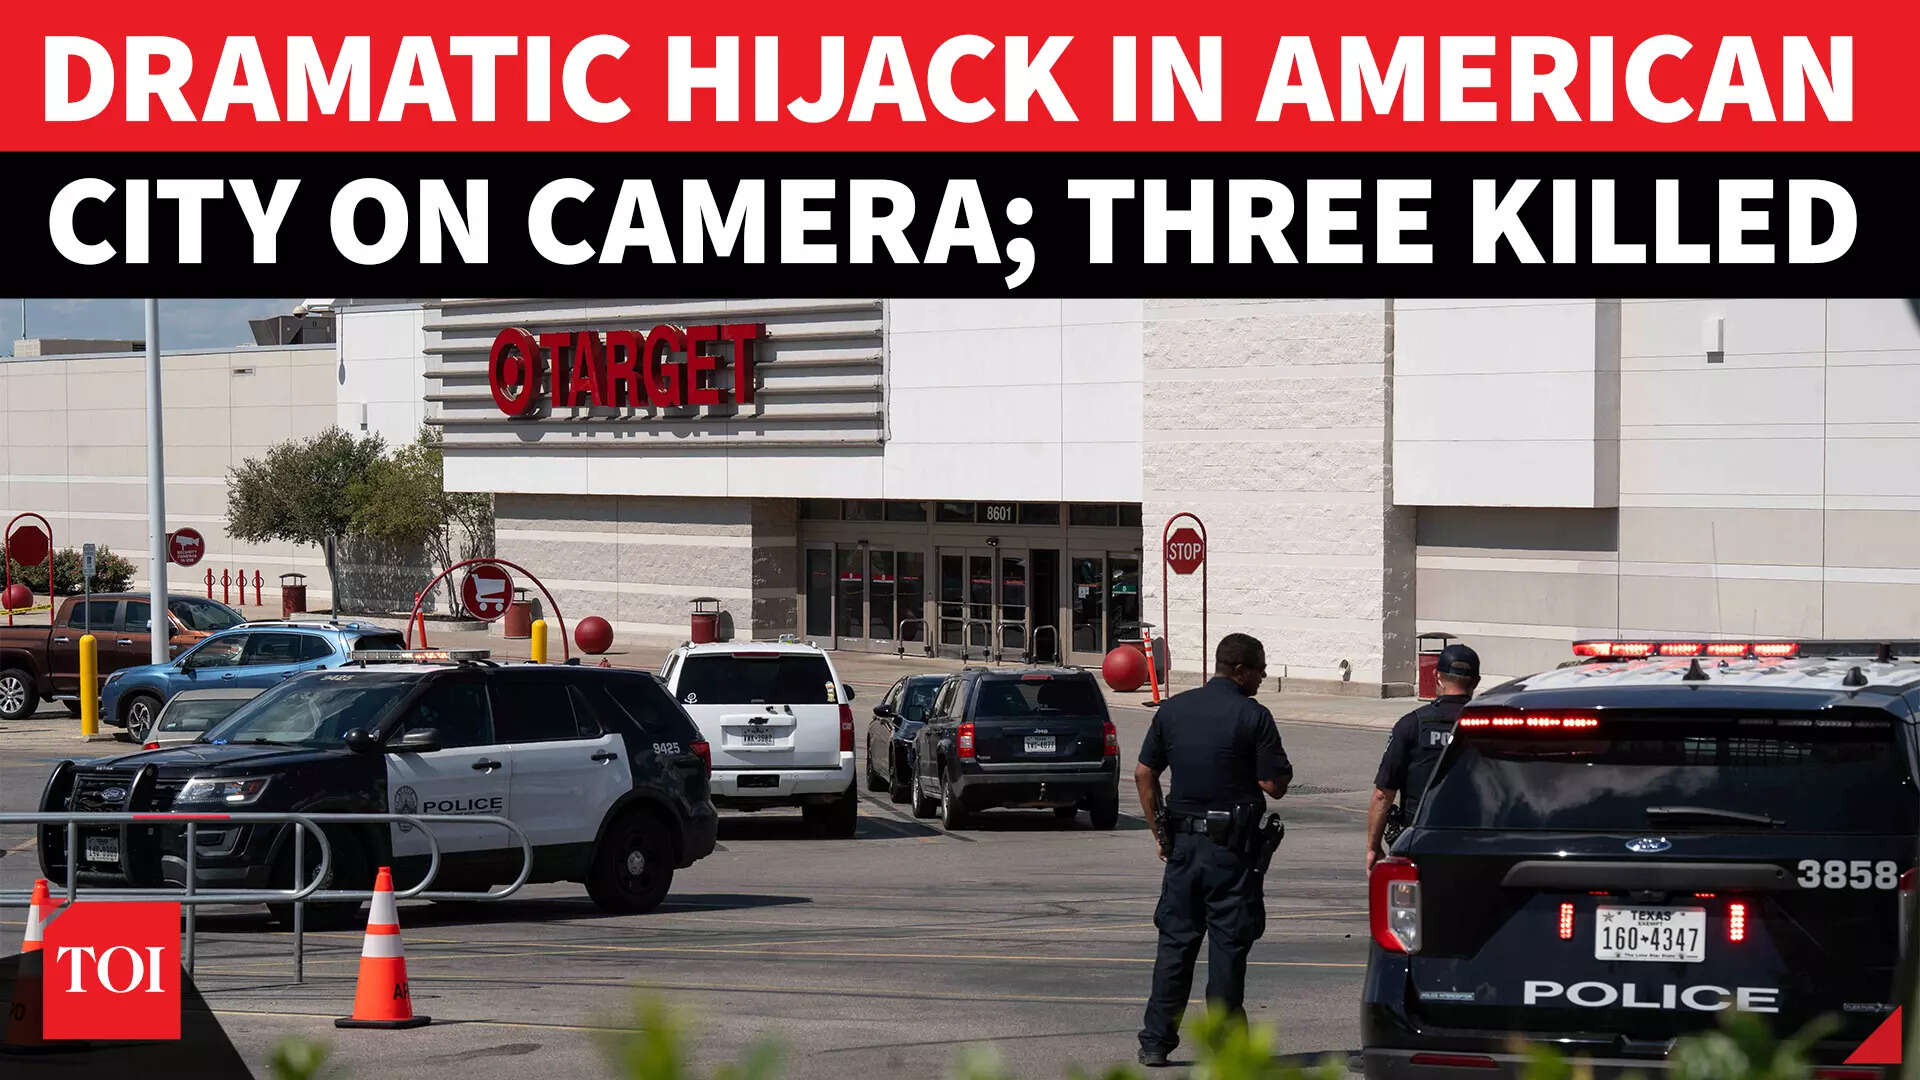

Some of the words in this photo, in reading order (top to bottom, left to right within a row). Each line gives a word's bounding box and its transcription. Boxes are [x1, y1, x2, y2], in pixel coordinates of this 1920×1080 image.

[540, 323, 766, 408] TARGET
[986, 506, 1012, 521] 8601
[1169, 543, 1201, 561] STOP
[653, 741, 681, 754] 9425
[423, 797, 503, 813] POLICE
[1797, 859, 1898, 890] 3858
[1631, 910, 1672, 921] TEXAS
[1523, 980, 1780, 1013] POLICE
